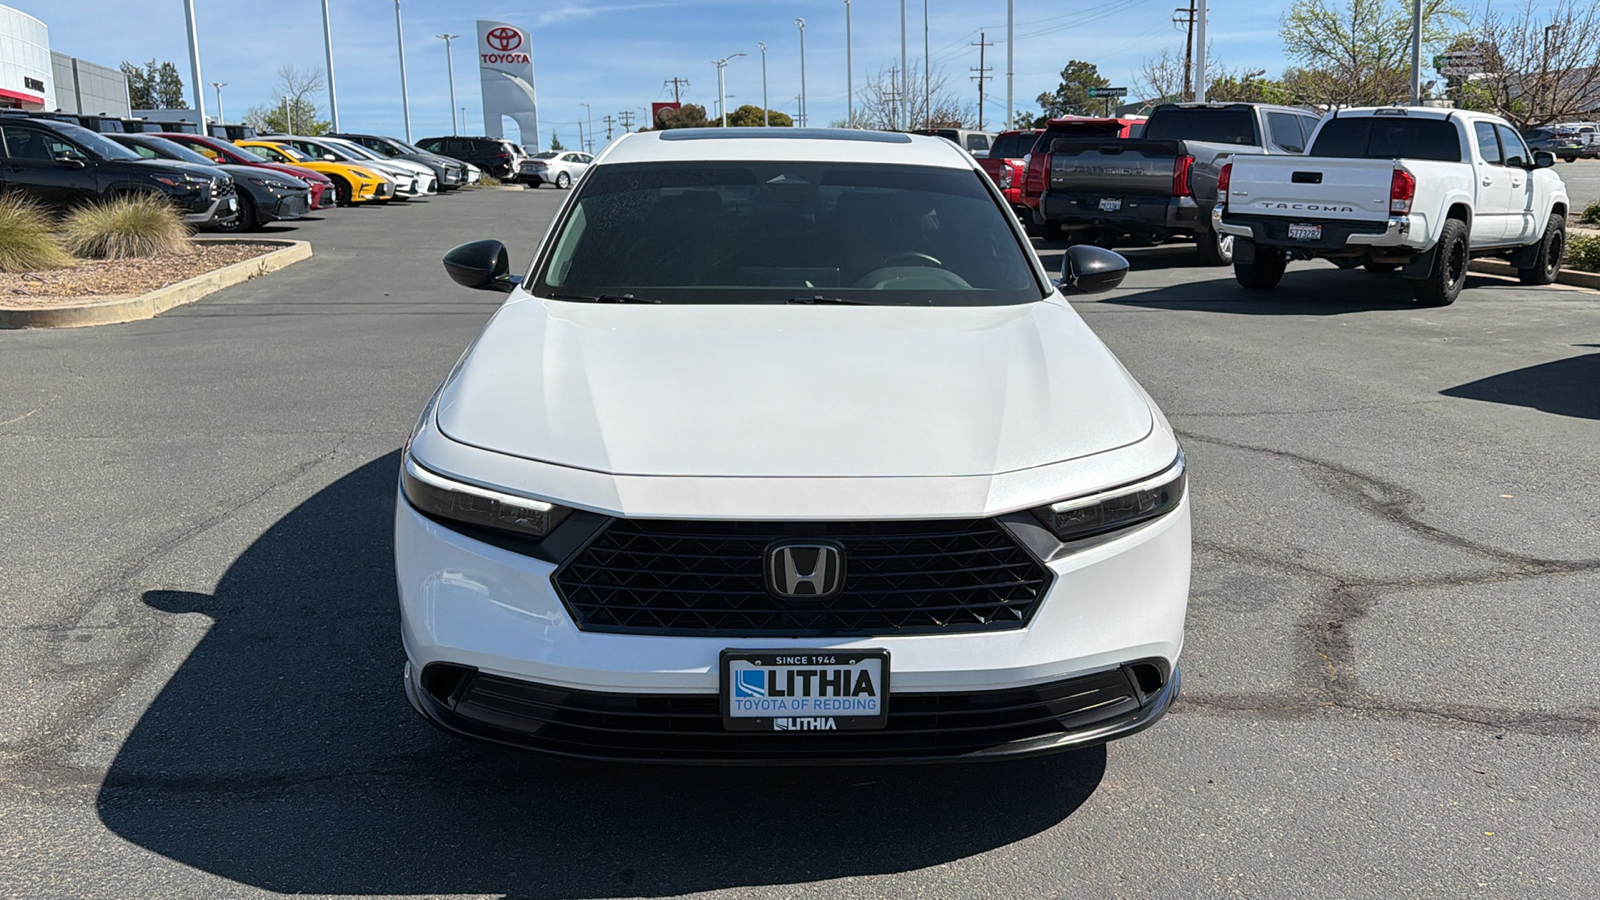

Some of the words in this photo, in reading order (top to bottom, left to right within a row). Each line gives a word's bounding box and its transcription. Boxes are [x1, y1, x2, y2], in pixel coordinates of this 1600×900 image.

[481, 53, 531, 64] TOYOTA
[1261, 202, 1353, 212] TACOMA
[776, 656, 808, 665] SINCE
[812, 656, 836, 664] 1946
[768, 669, 876, 697] LITHIA
[735, 699, 787, 711] TOYOTA
[791, 699, 809, 710] OF
[813, 698, 876, 710] REDDING
[787, 717, 837, 731] LITHIA
